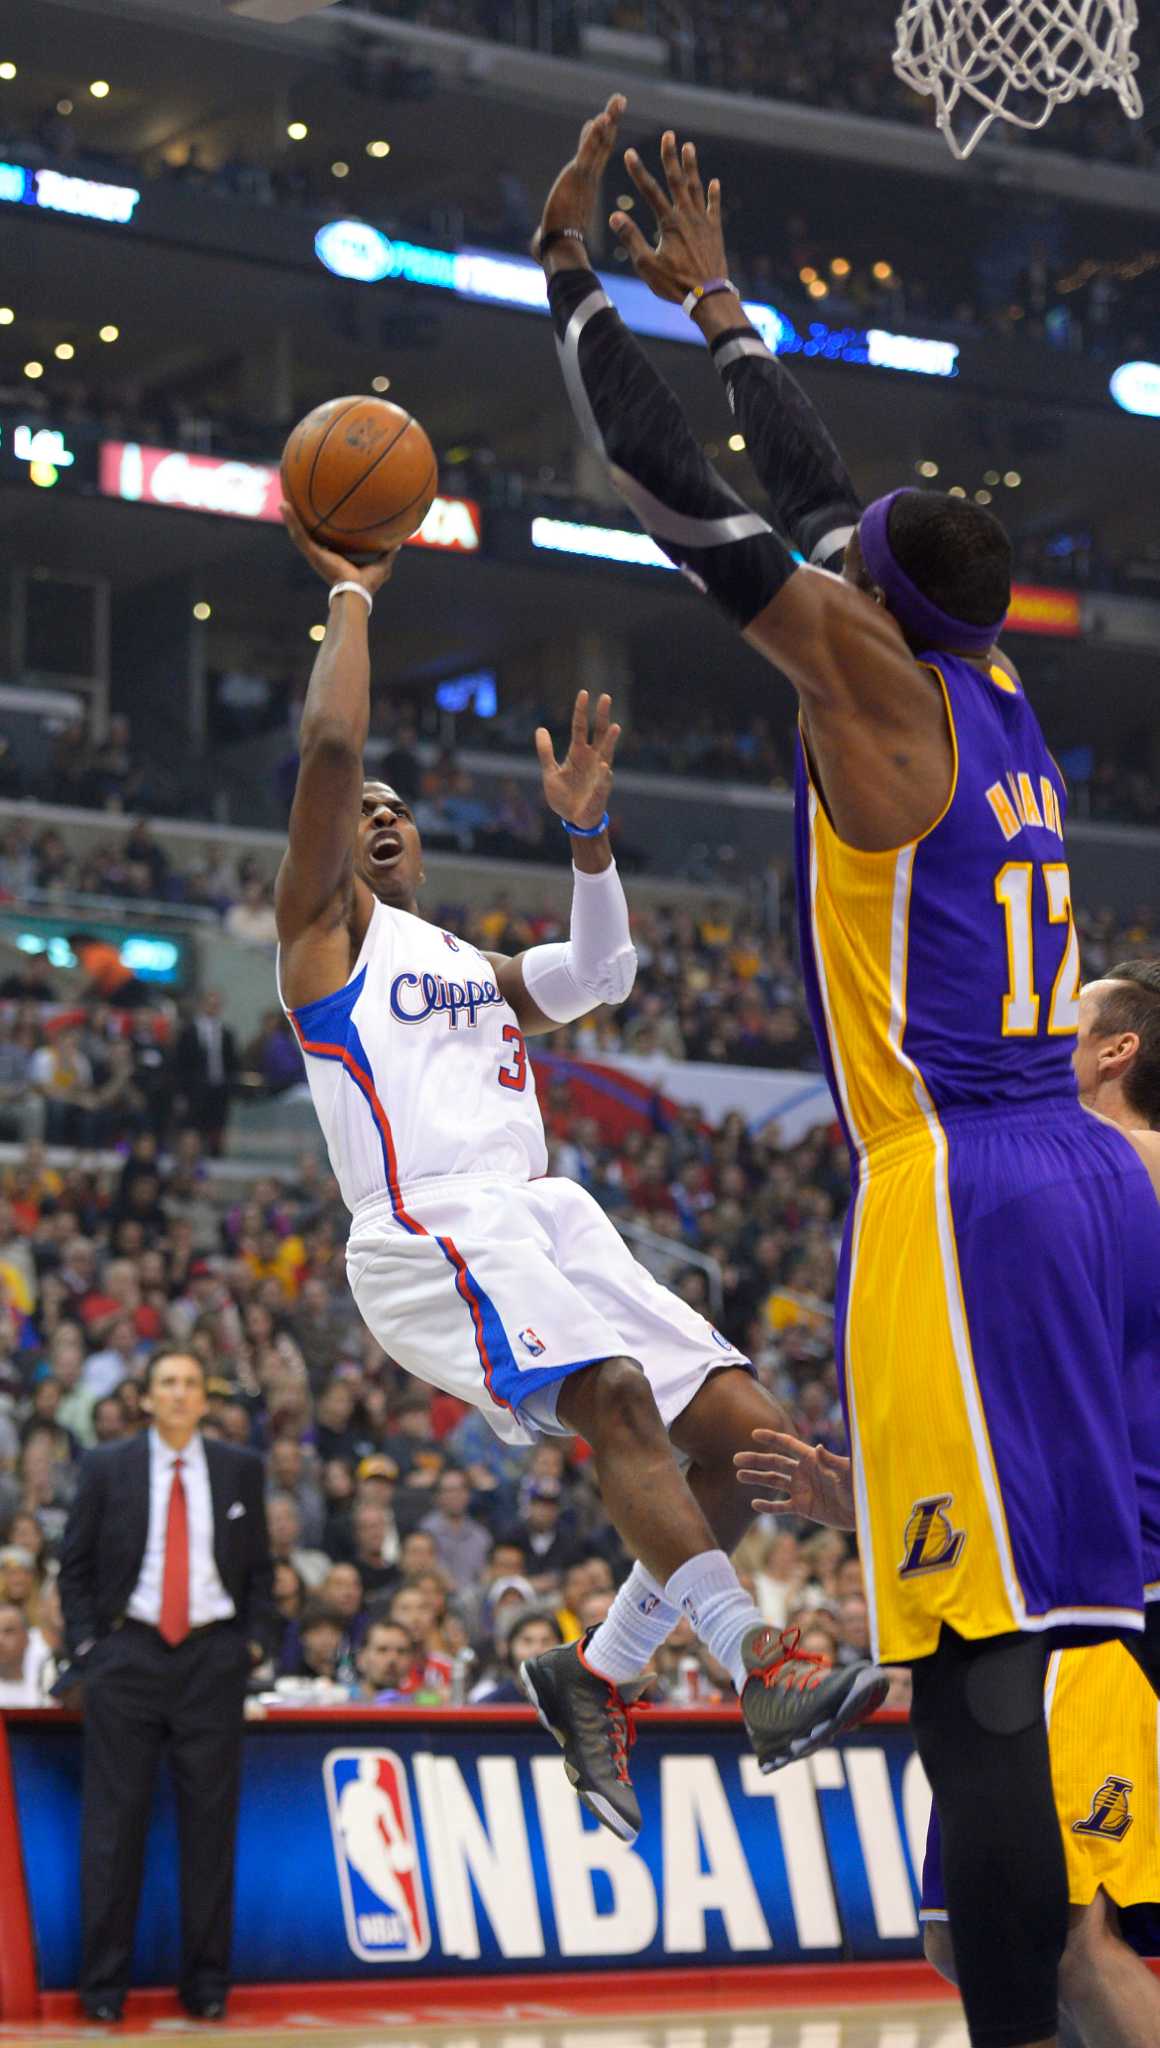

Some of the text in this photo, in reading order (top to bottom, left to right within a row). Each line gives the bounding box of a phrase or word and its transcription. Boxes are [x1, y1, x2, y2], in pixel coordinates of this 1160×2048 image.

[994, 861, 1082, 1037] 12
[389, 968, 506, 1030] Clippe
[498, 1023, 527, 1092] 3
[897, 1492, 968, 1579] L
[1072, 1775, 1135, 1842] L
[412, 1744, 932, 1960] NBATI
